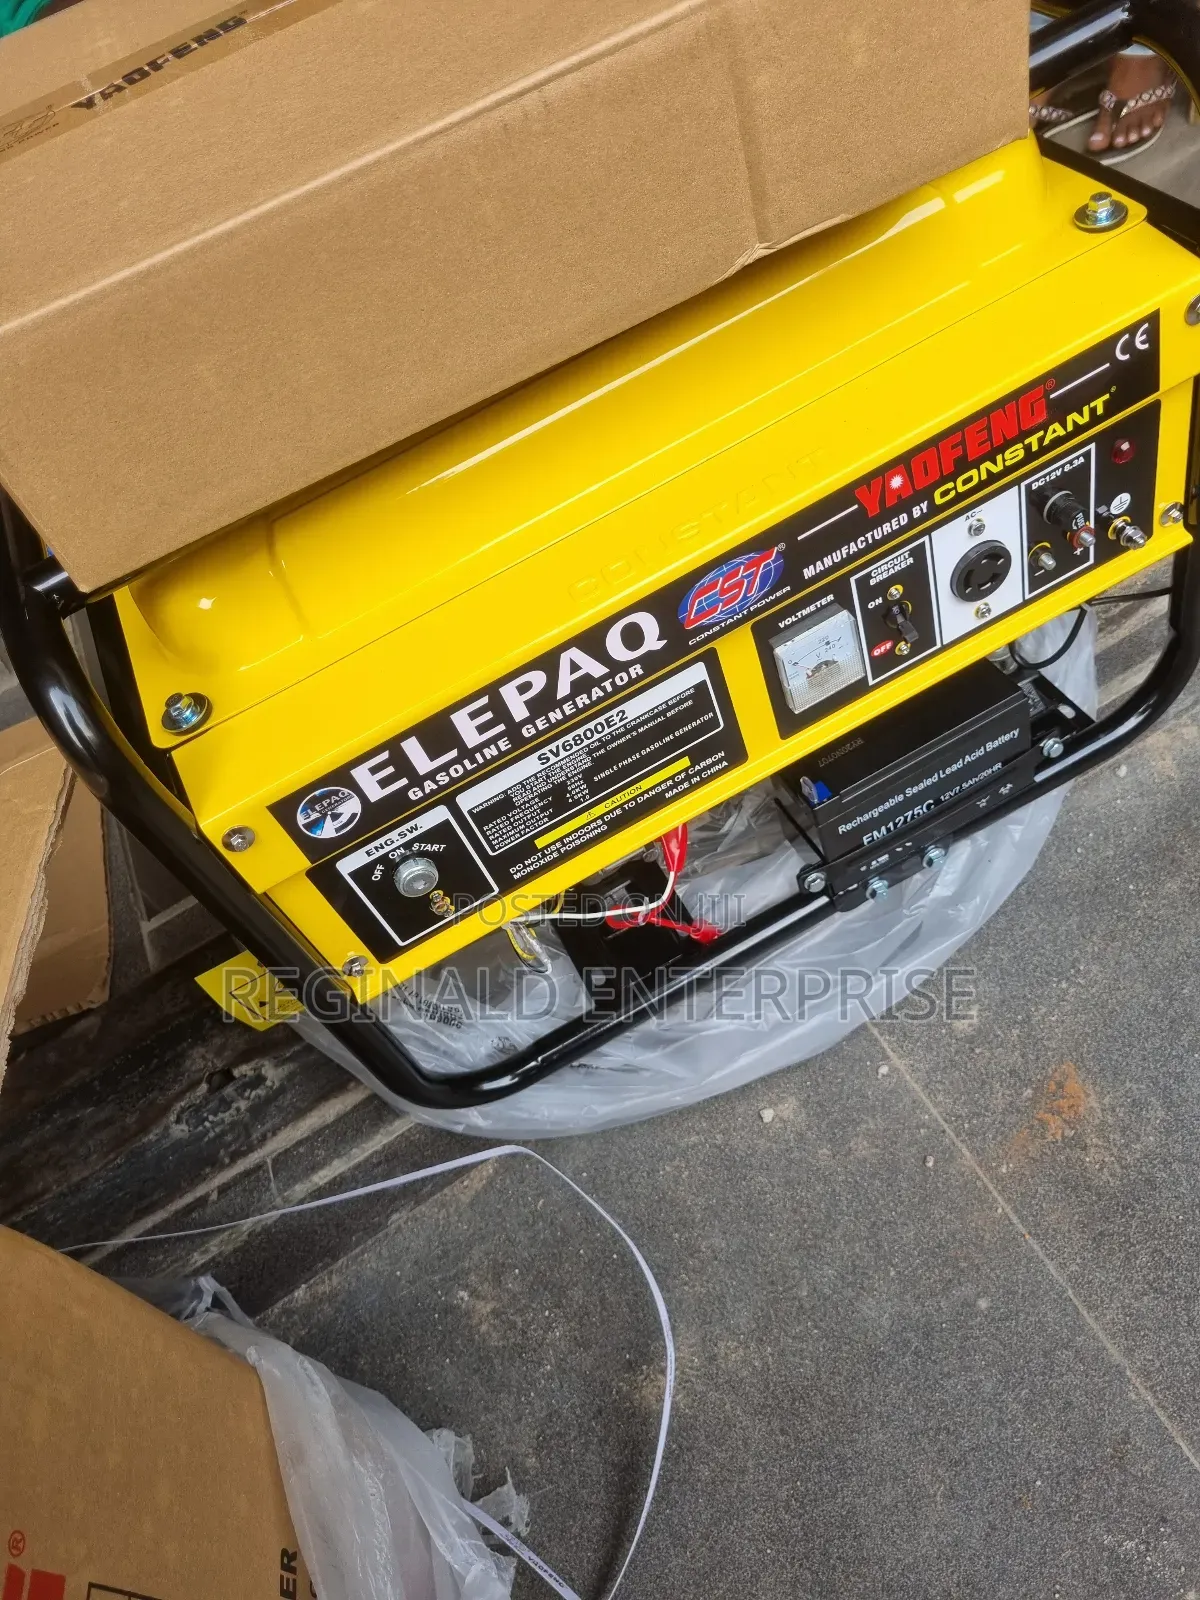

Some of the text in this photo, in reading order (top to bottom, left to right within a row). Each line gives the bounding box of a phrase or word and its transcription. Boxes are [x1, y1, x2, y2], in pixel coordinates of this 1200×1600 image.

[70, 16, 248, 110] YAOFENG
[854, 386, 1049, 519] YAOFENG
[933, 394, 1112, 506] CONSTANT
[1031, 455, 1086, 490] DC12V 8.3A
[803, 499, 930, 580] MANUFACTURED BY
[869, 557, 914, 586] BREAKER
[870, 551, 912, 578] CIRCUIT
[688, 585, 792, 646] CONSTANT POWER
[778, 593, 835, 629] VOLTMETER
[867, 597, 883, 610] ON
[873, 641, 893, 657] OFF
[349, 611, 668, 803] ELEPAQ
[407, 663, 645, 801] GASOLINE GENERATOR
[472, 687, 695, 814] WARNING: ADD THE RECOMMENDED OIL TO THE CRANKCASE BEFORE
[512, 699, 693, 803] READ AND UNDERSTAND THE OWNER'S MANUAL BEFORE
[537, 709, 629, 767] SV6800E2
[593, 712, 714, 781] SINGLE PHASE GASOLINE GENERATOR
[510, 789, 525, 799] YOU
[525, 777, 547, 791] START
[547, 768, 562, 780] THE
[515, 762, 595, 806] OPERATING THE ENGINE.
[604, 784, 643, 810] CAUTION
[664, 760, 729, 799] MADE IN CHINA
[838, 727, 1021, 836] Rechargeable Sealed Lead Acid Battery
[300, 790, 350, 821] ELEPAQ
[483, 816, 507, 831] RATED
[507, 799, 541, 818] VOLTAGE
[486, 820, 510, 836] RATED
[510, 796, 553, 822] FREQUENCY
[488, 824, 513, 841] RATED
[513, 808, 541, 827] OUTPUT
[494, 795, 590, 850] POWER FACTOR 1.0
[509, 751, 725, 874] DO NOT USE INDOORS DUE TO DANGER OF CARBON
[492, 825, 525, 845] MAXIMUM
[525, 808, 554, 827] OUTPUT
[388, 846, 406, 859] ON
[412, 842, 447, 852] START
[513, 824, 608, 880] MONOXIDE POISONING
[371, 863, 385, 881] OFF
